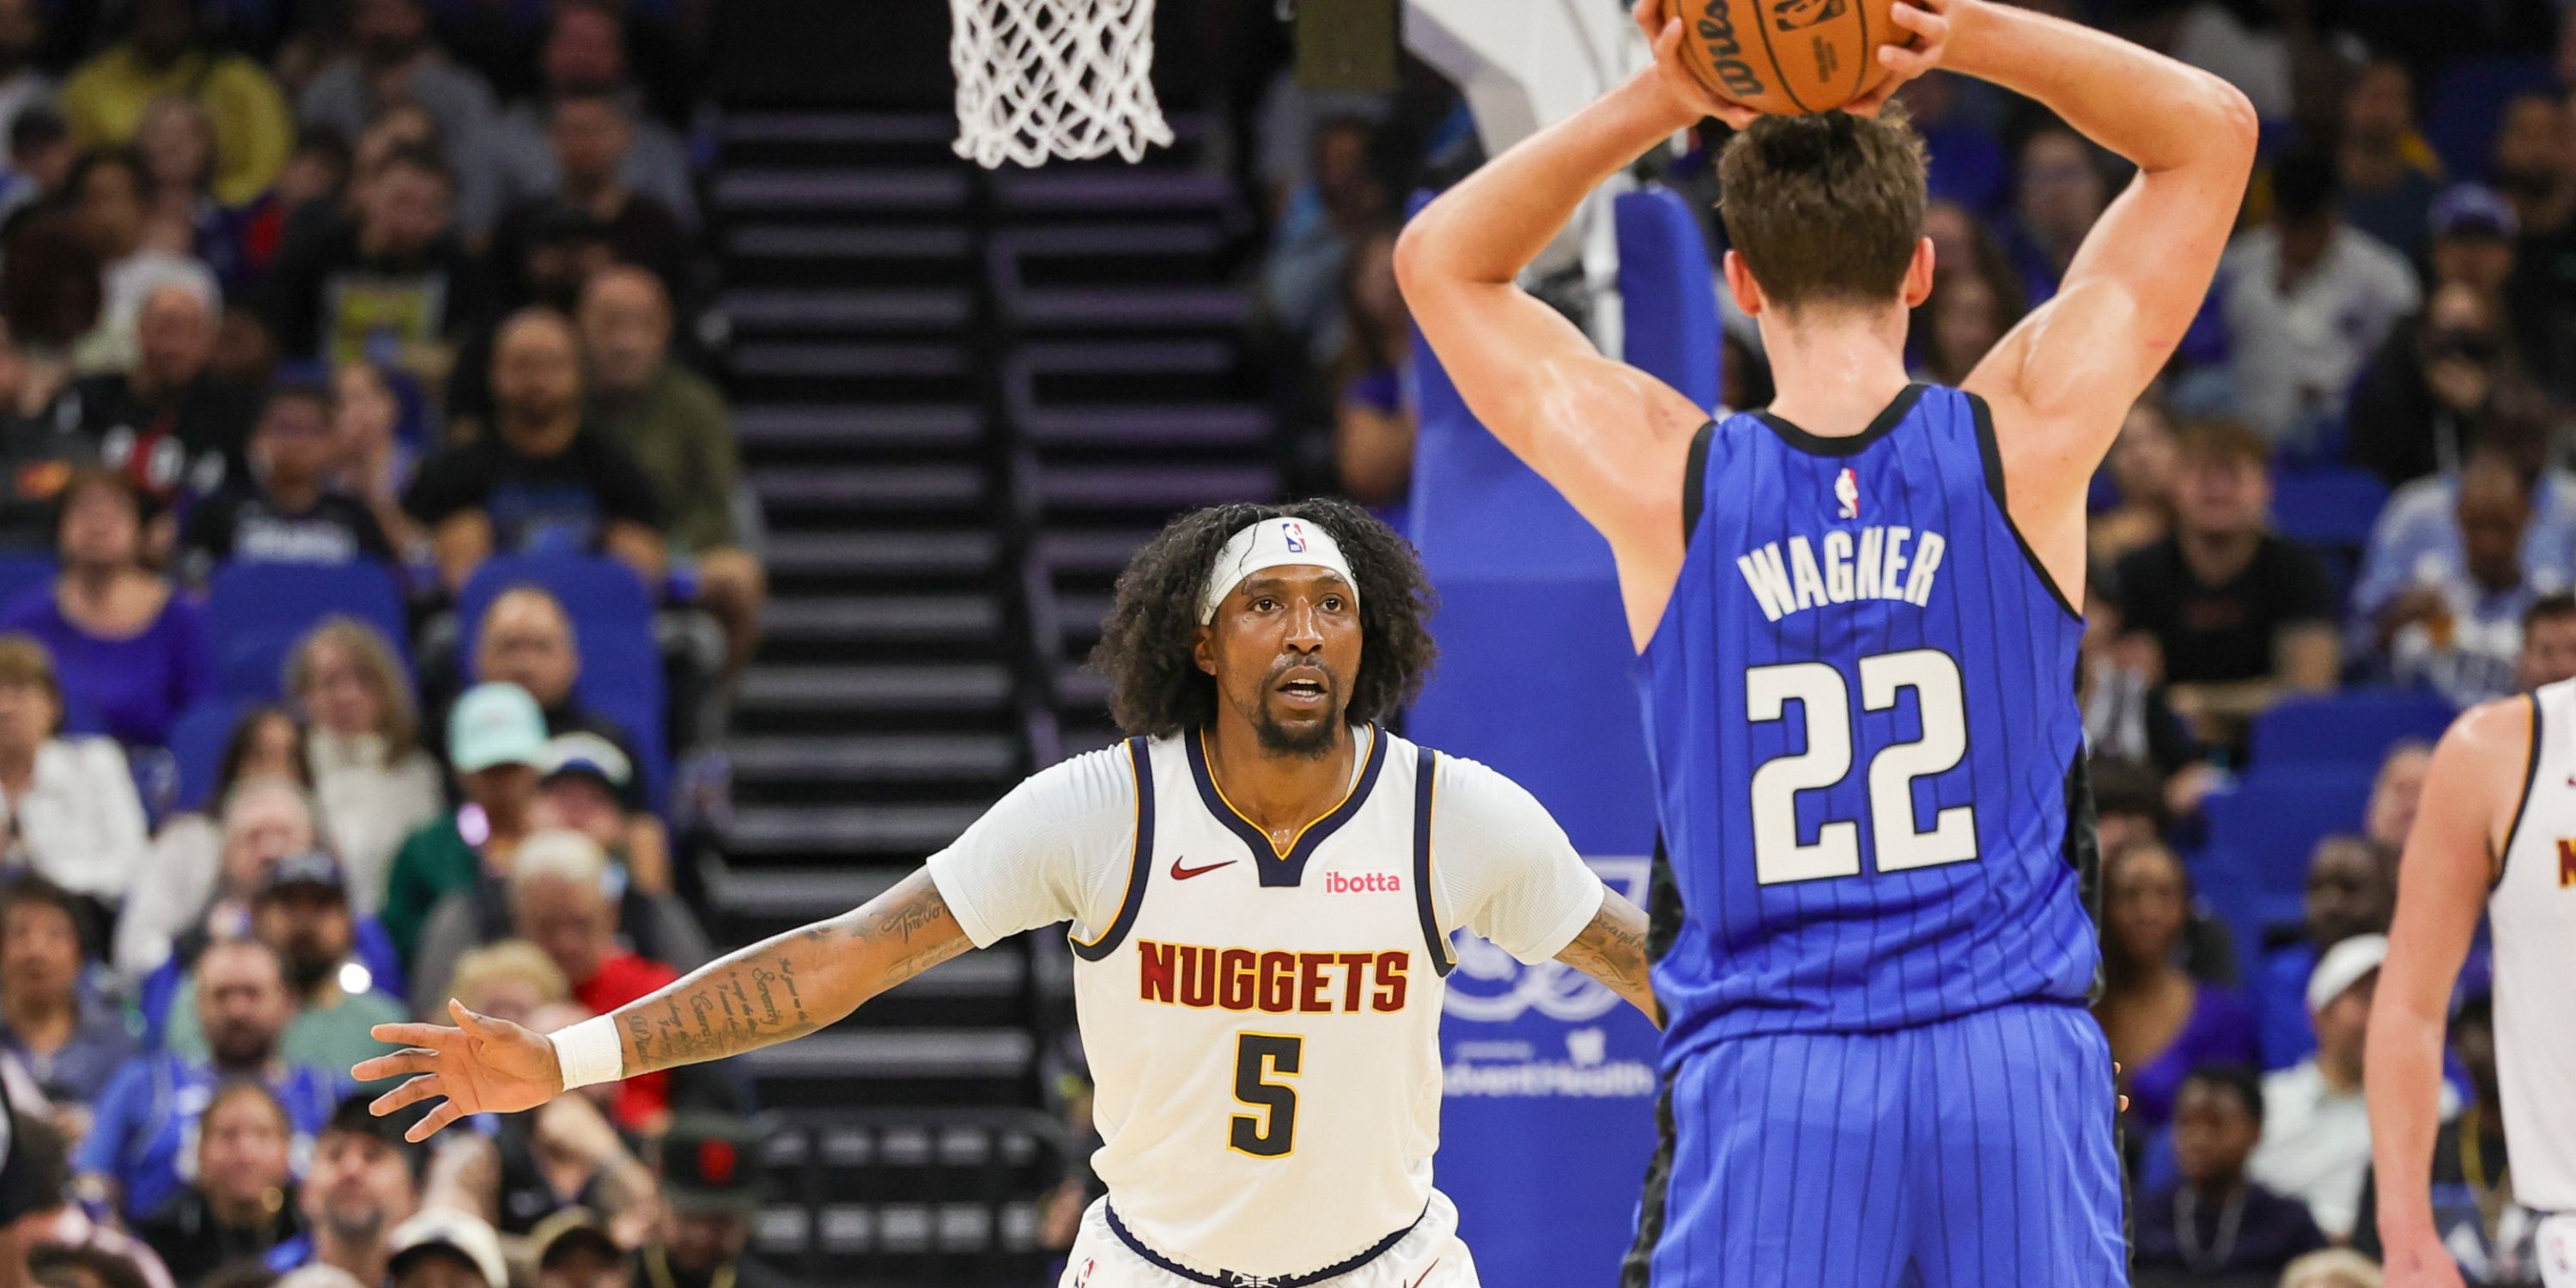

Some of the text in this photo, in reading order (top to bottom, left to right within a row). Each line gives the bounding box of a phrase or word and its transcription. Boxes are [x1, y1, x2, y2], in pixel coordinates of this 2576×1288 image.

[1736, 526, 1946, 623] WAGNER
[1746, 648, 1979, 887] 22
[1326, 872, 1400, 894] ibotta
[1136, 938, 1411, 1015] NUGGETS
[1226, 1030, 1305, 1159] 5
